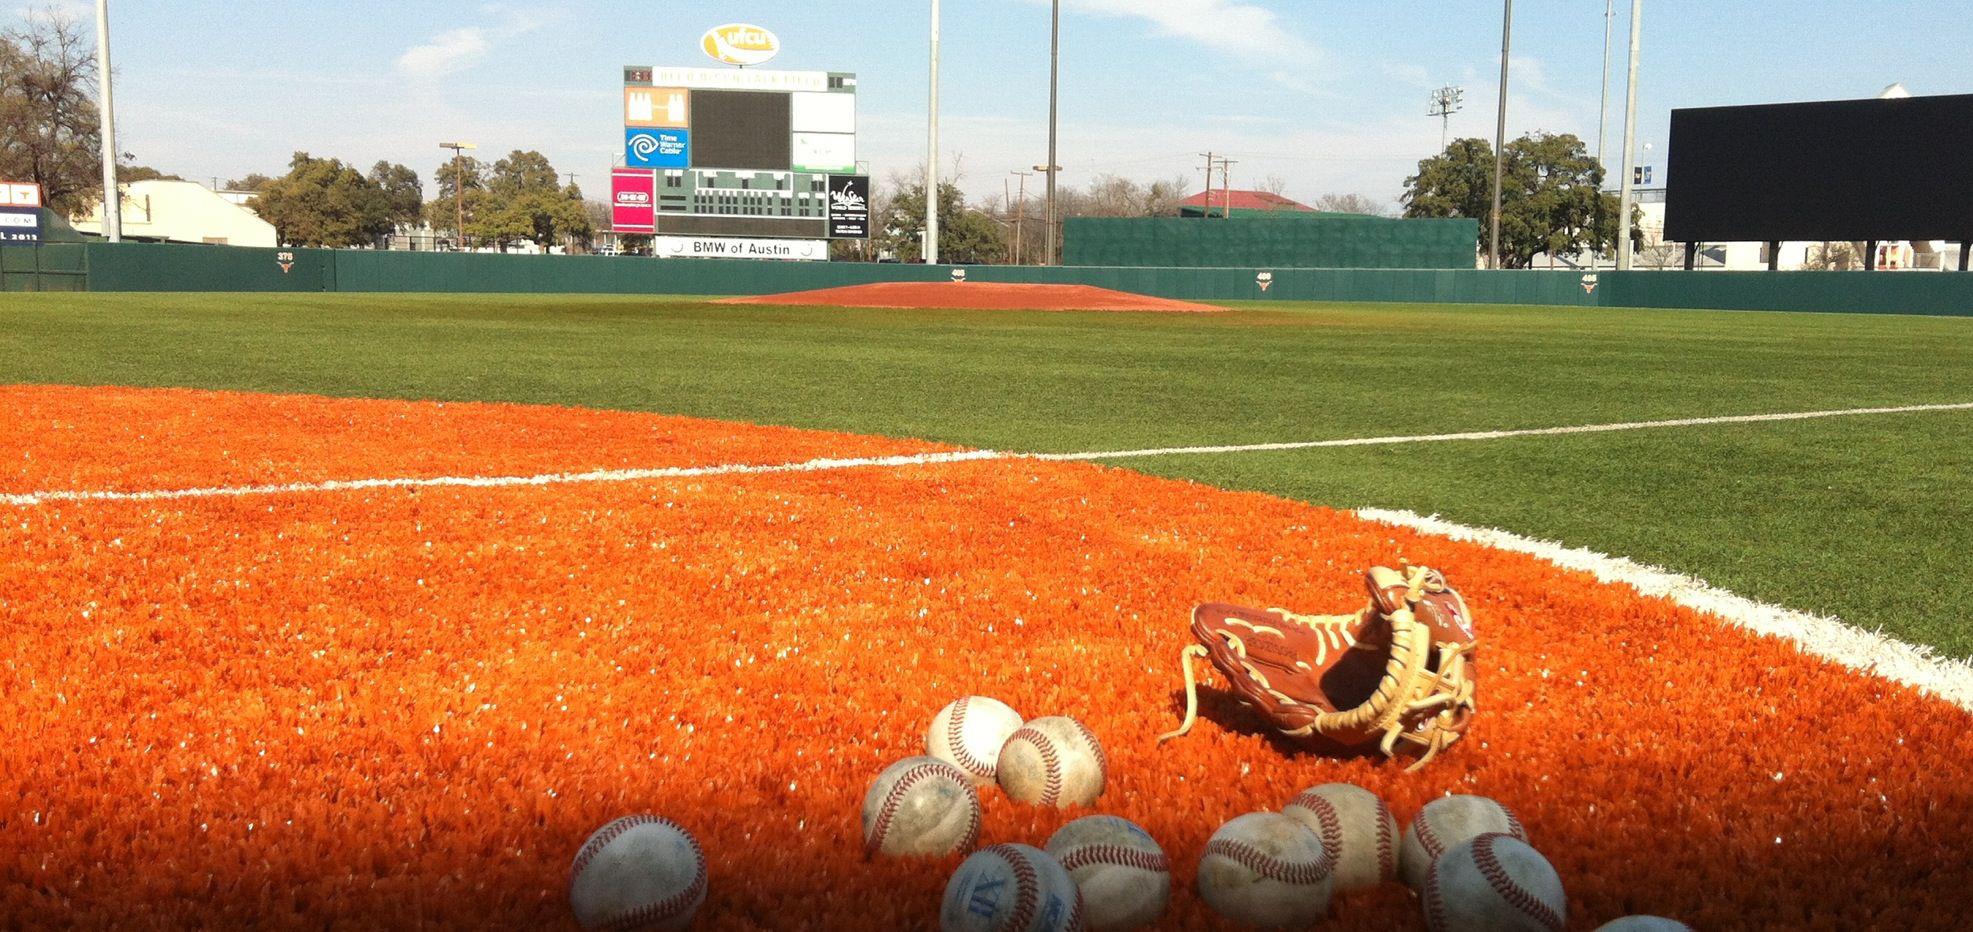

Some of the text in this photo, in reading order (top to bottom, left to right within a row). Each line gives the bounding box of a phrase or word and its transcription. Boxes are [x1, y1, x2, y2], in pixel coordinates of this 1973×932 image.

[694, 241, 790, 255] BMW of Austin
